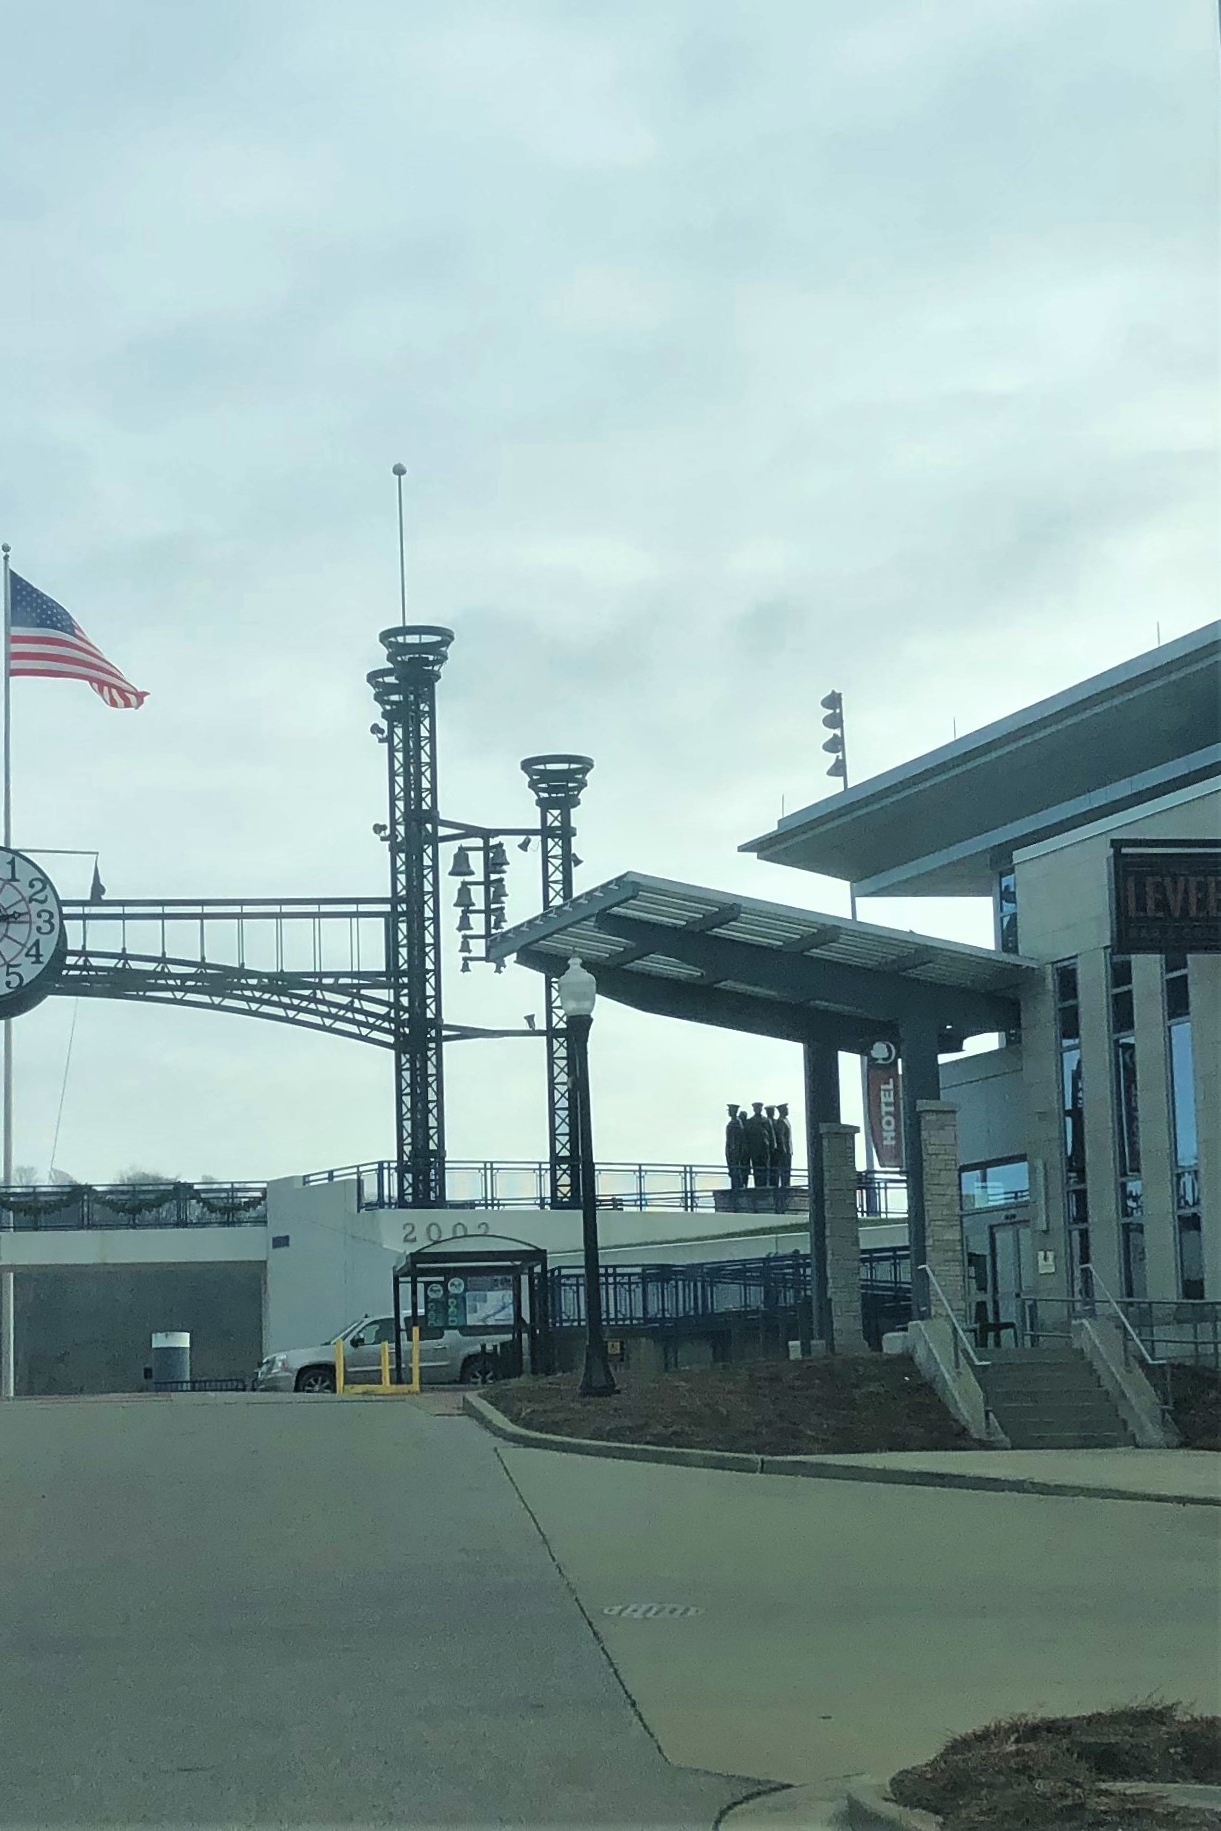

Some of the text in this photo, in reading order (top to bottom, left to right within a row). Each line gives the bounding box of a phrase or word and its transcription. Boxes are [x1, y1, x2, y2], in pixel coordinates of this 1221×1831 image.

[6, 857, 20, 882] 1
[28, 878, 48, 904] 2
[36, 909, 55, 935] 3
[25, 939, 44, 964] 4
[5, 964, 24, 989] 5
[880, 1078, 896, 1146] HOTEL
